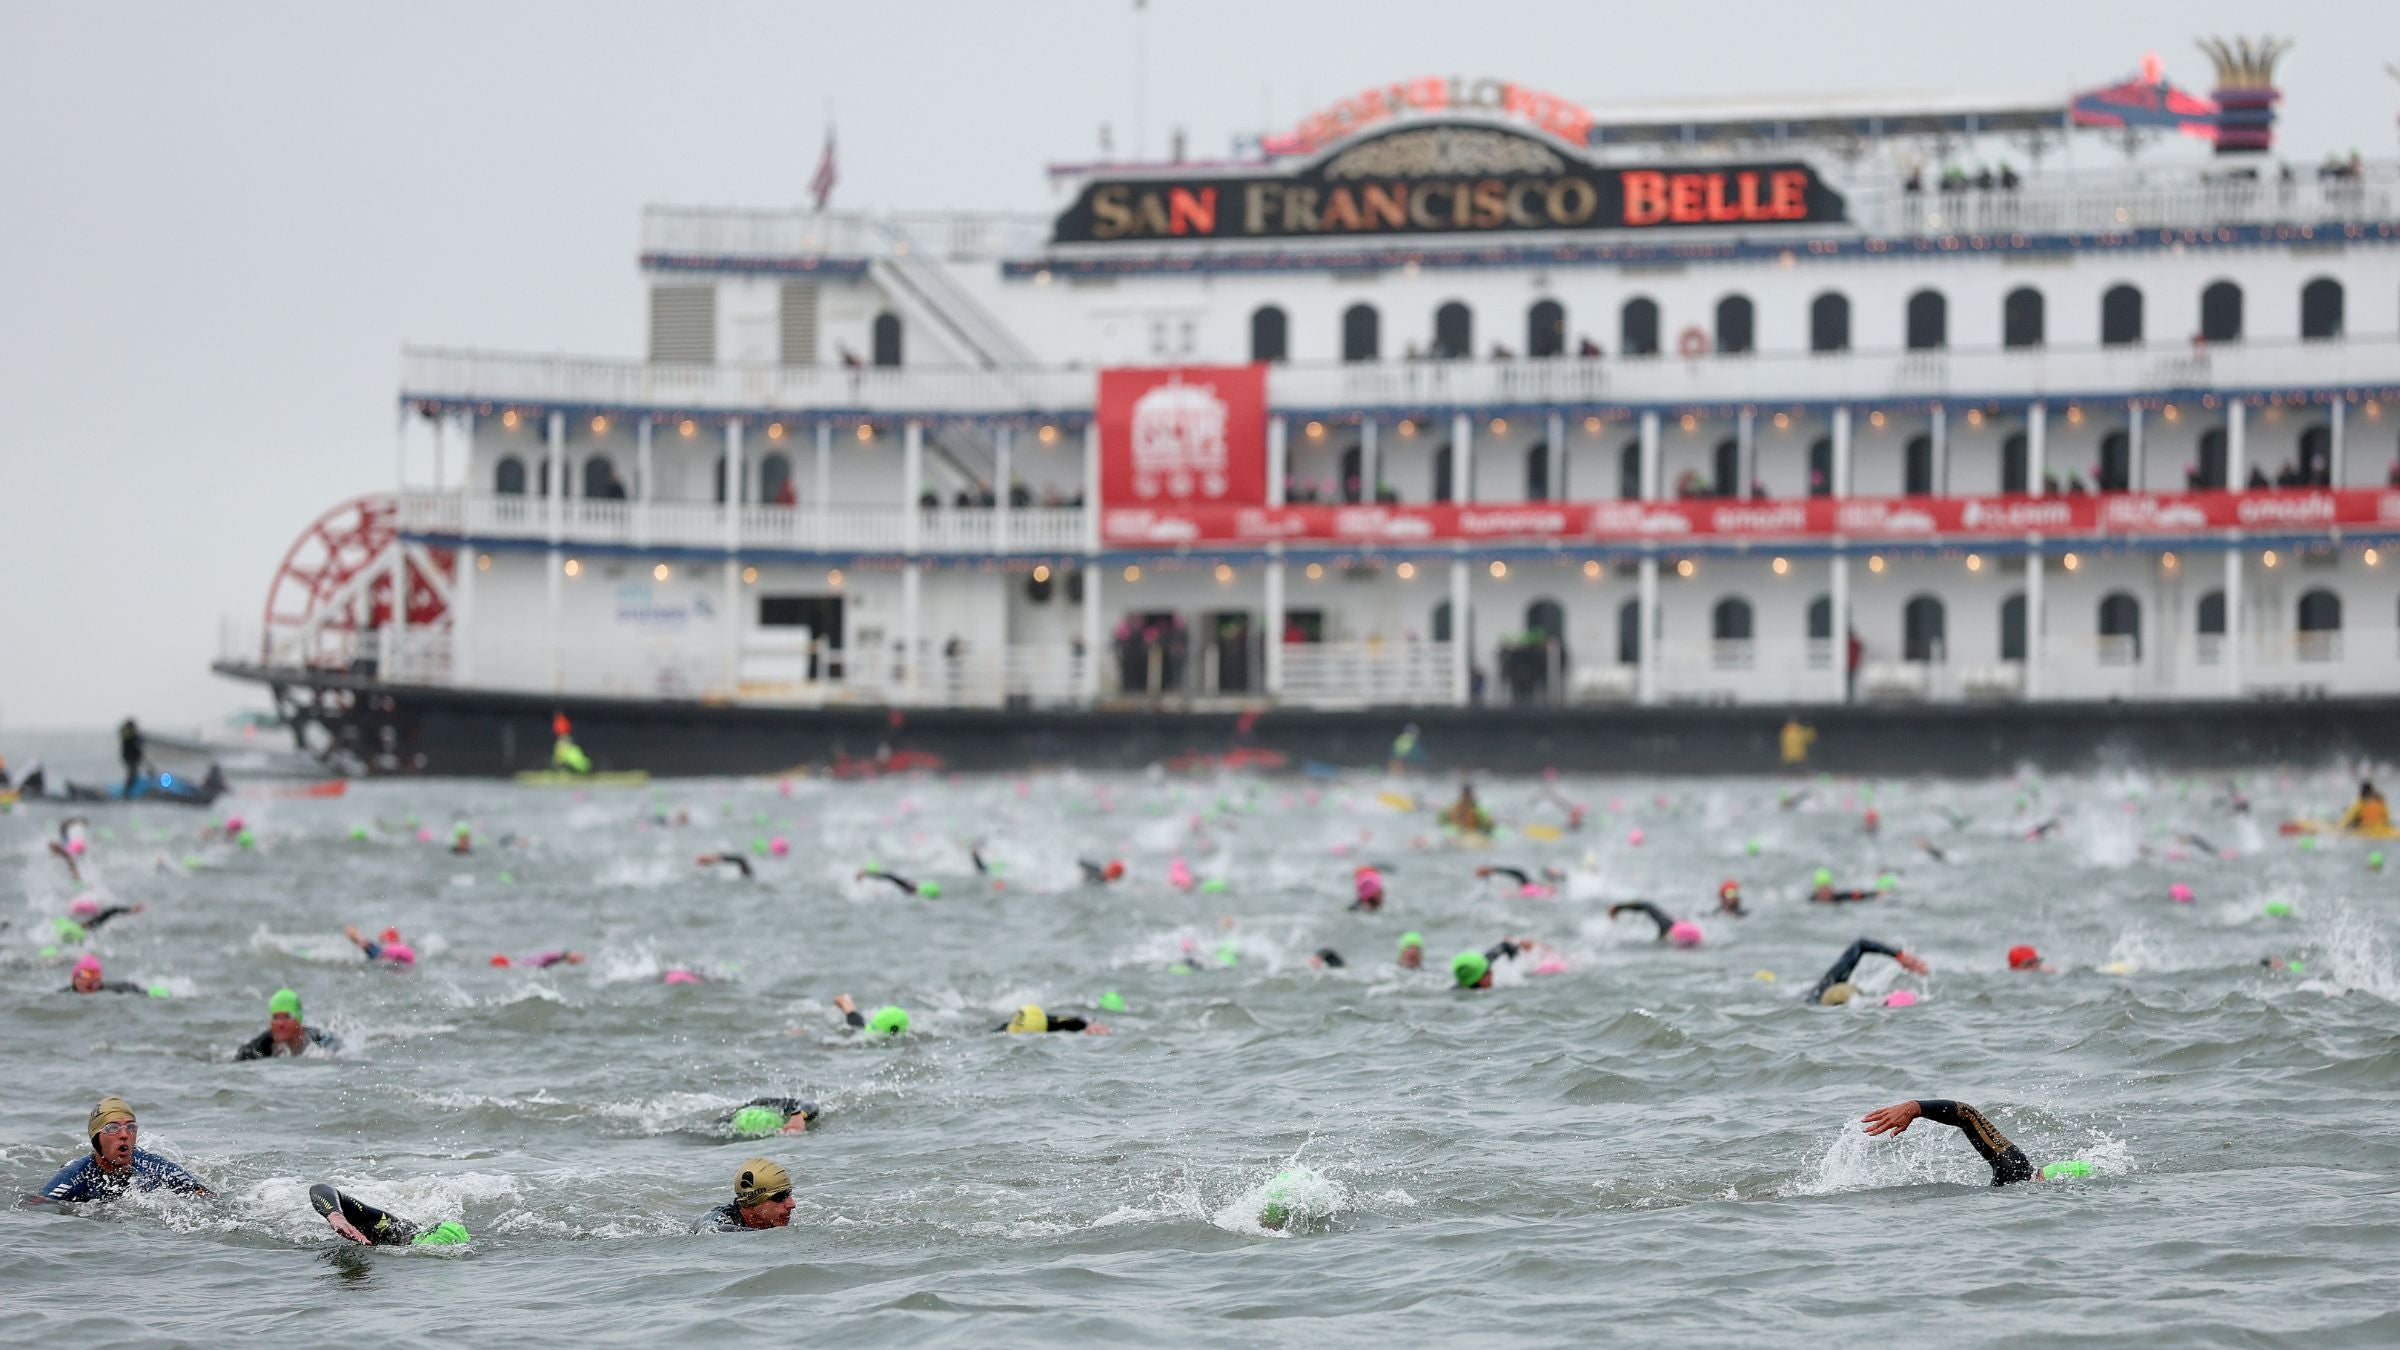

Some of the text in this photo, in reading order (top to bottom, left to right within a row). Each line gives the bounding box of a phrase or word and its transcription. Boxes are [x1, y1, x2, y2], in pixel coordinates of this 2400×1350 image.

[1091, 170, 1808, 237] SAN FRANCISCO BELLE
[134, 1156, 168, 1175] HELIX
